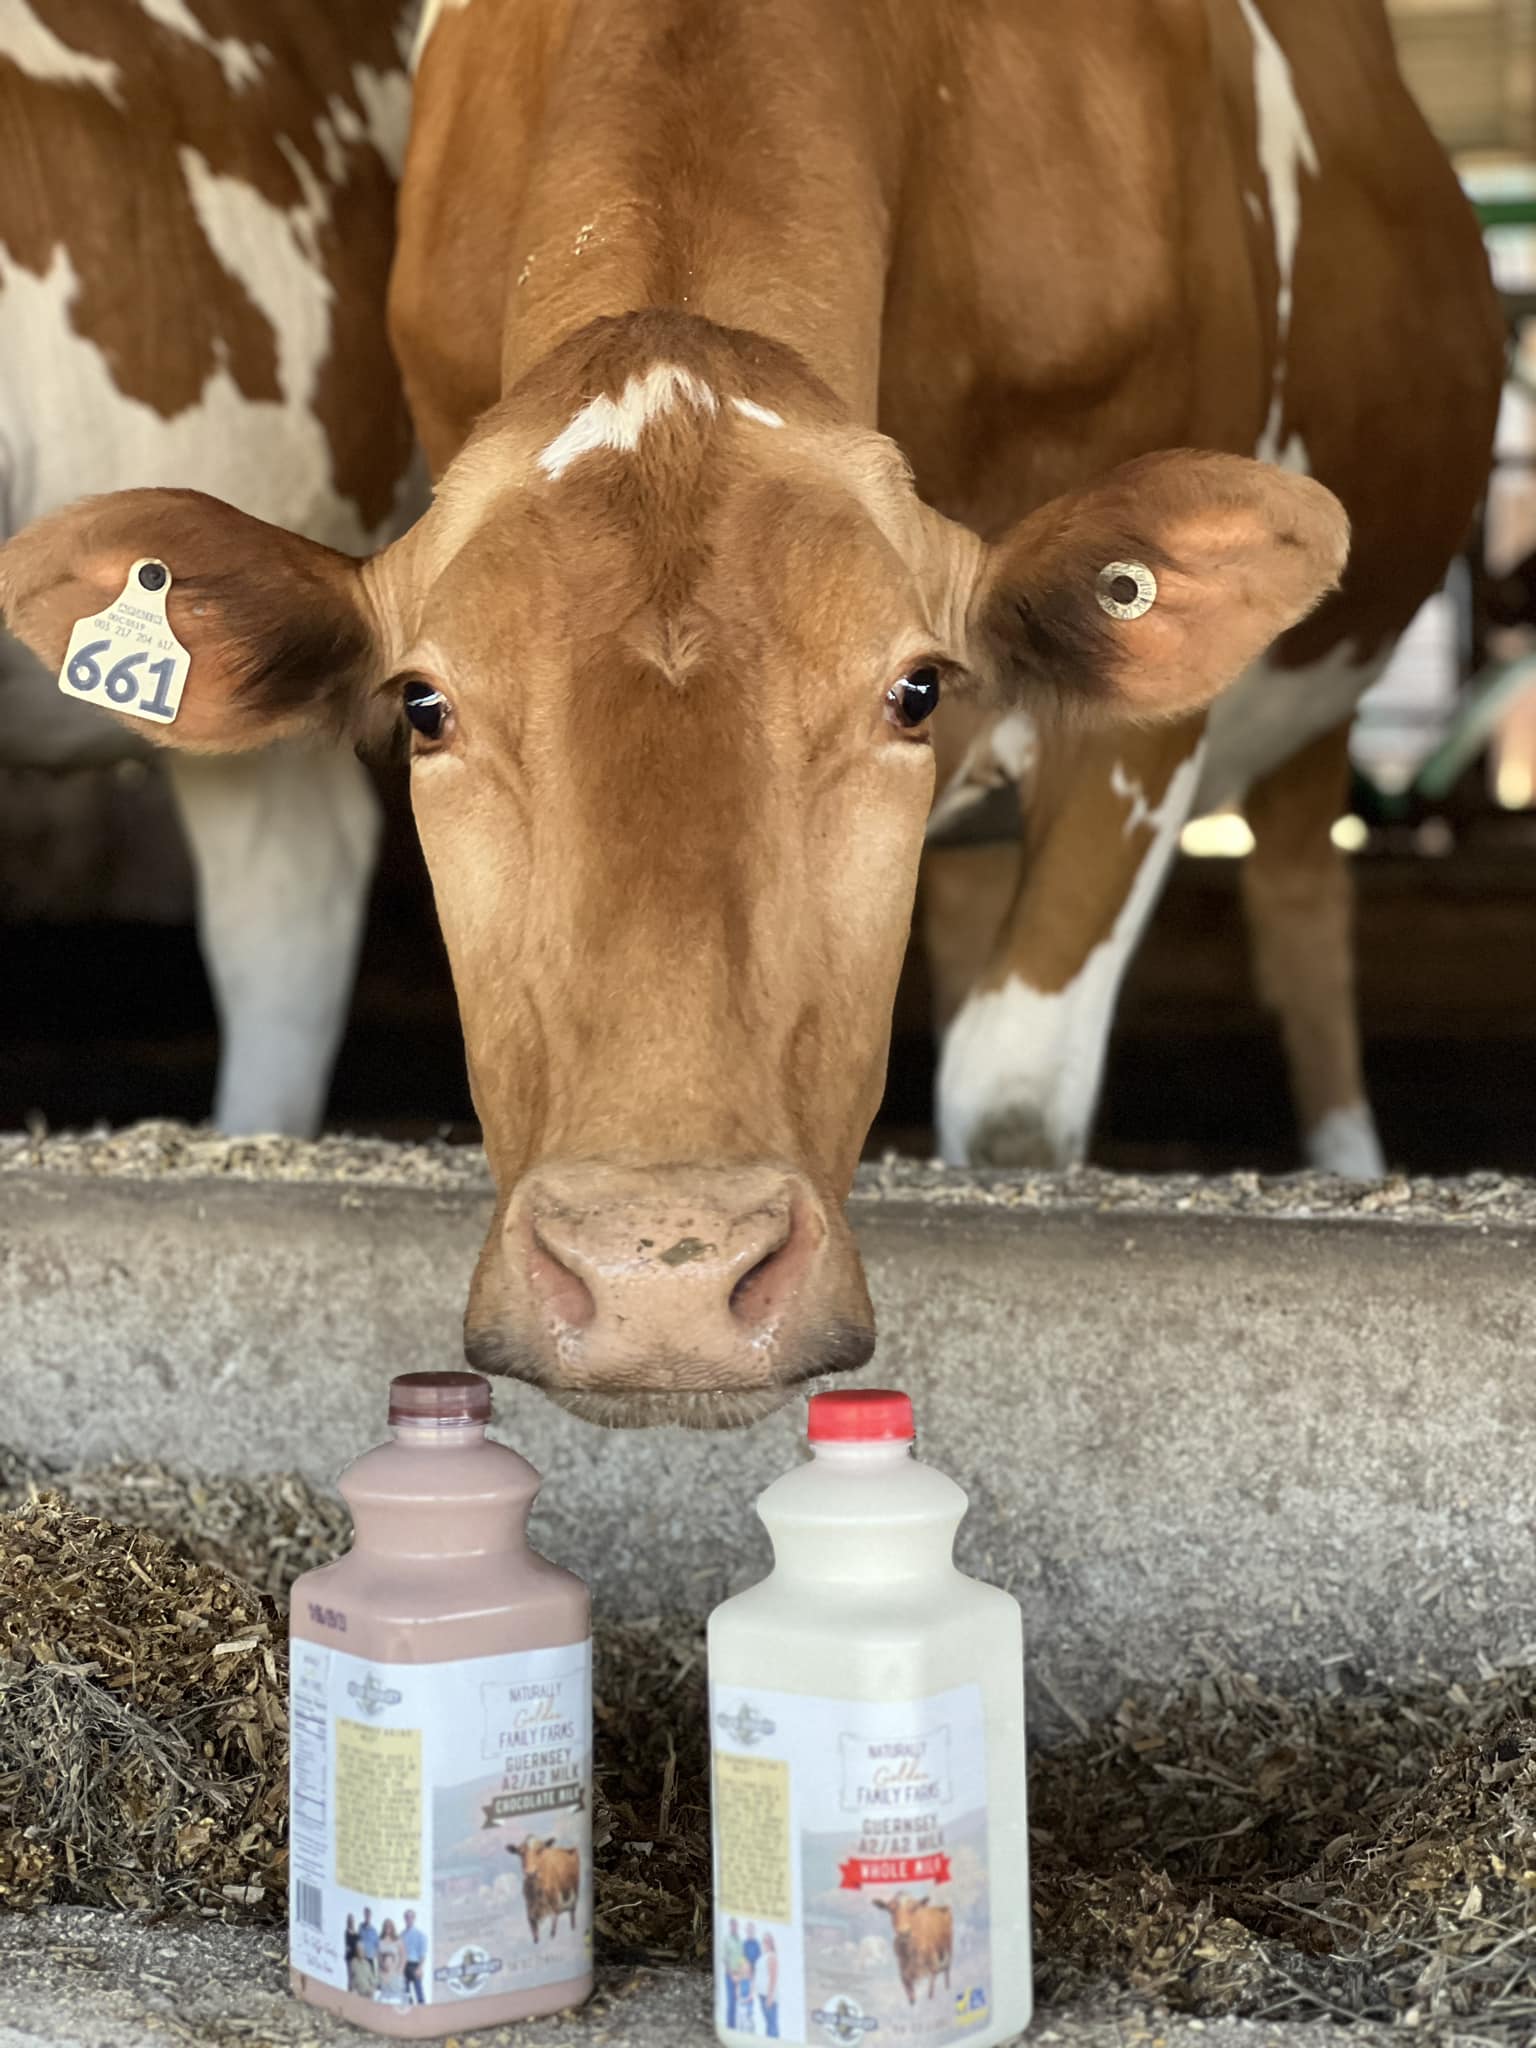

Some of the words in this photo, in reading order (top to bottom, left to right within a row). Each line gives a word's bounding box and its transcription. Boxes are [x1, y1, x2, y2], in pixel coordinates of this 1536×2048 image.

[67, 639, 176, 718] 661
[499, 1728, 538, 1748] FAMILY
[540, 1721, 575, 1741] FARMS
[505, 1747, 572, 1773] GUERNSEY
[501, 1770, 546, 1791] A2/A2
[550, 1763, 579, 1783] MILK
[495, 1789, 555, 1814] CHOCOLATE
[862, 1814, 938, 1836] GUERNSEY
[858, 1836, 911, 1854] A2/A2
[860, 1860, 907, 1879] WHOLE
